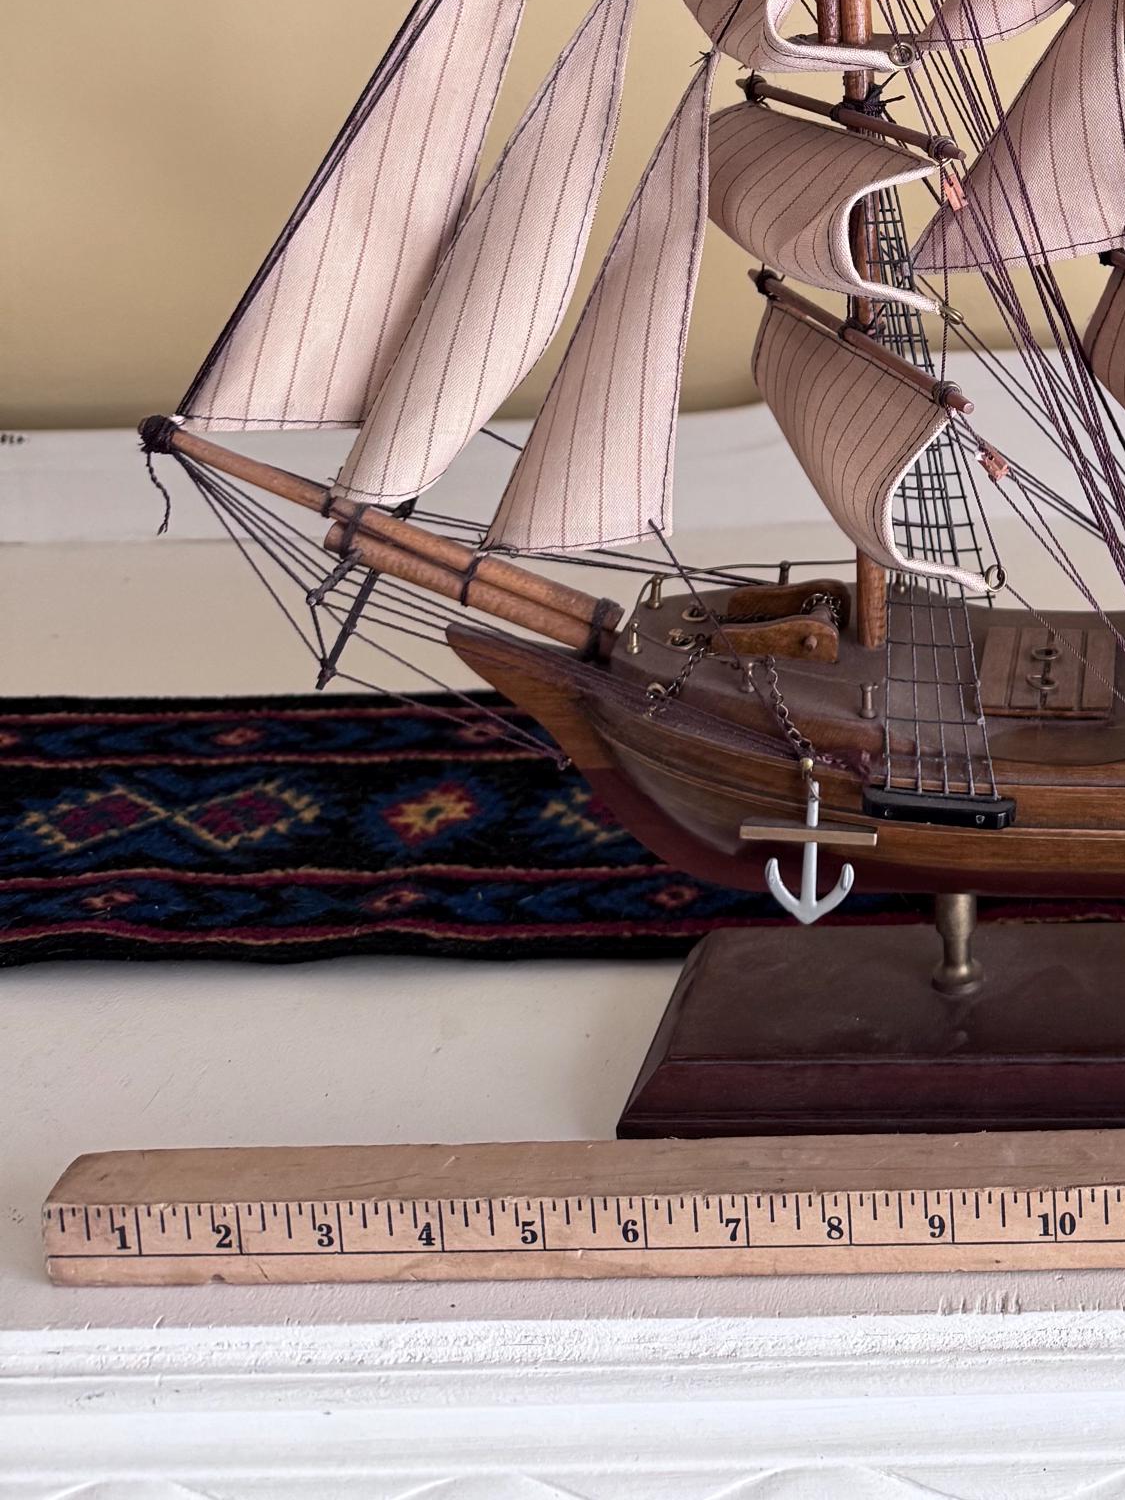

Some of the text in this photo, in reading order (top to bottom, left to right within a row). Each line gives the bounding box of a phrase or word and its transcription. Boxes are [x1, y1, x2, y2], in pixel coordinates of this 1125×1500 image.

[115, 1225, 132, 1250] 1
[215, 1224, 233, 1248] 2
[317, 1223, 335, 1247] 3
[417, 1222, 436, 1247] 4
[520, 1220, 539, 1245] 5
[621, 1219, 640, 1243] 6
[724, 1217, 742, 1242] 7
[826, 1216, 845, 1240] 8
[928, 1214, 946, 1239] 9
[1037, 1211, 1077, 1237] 10
